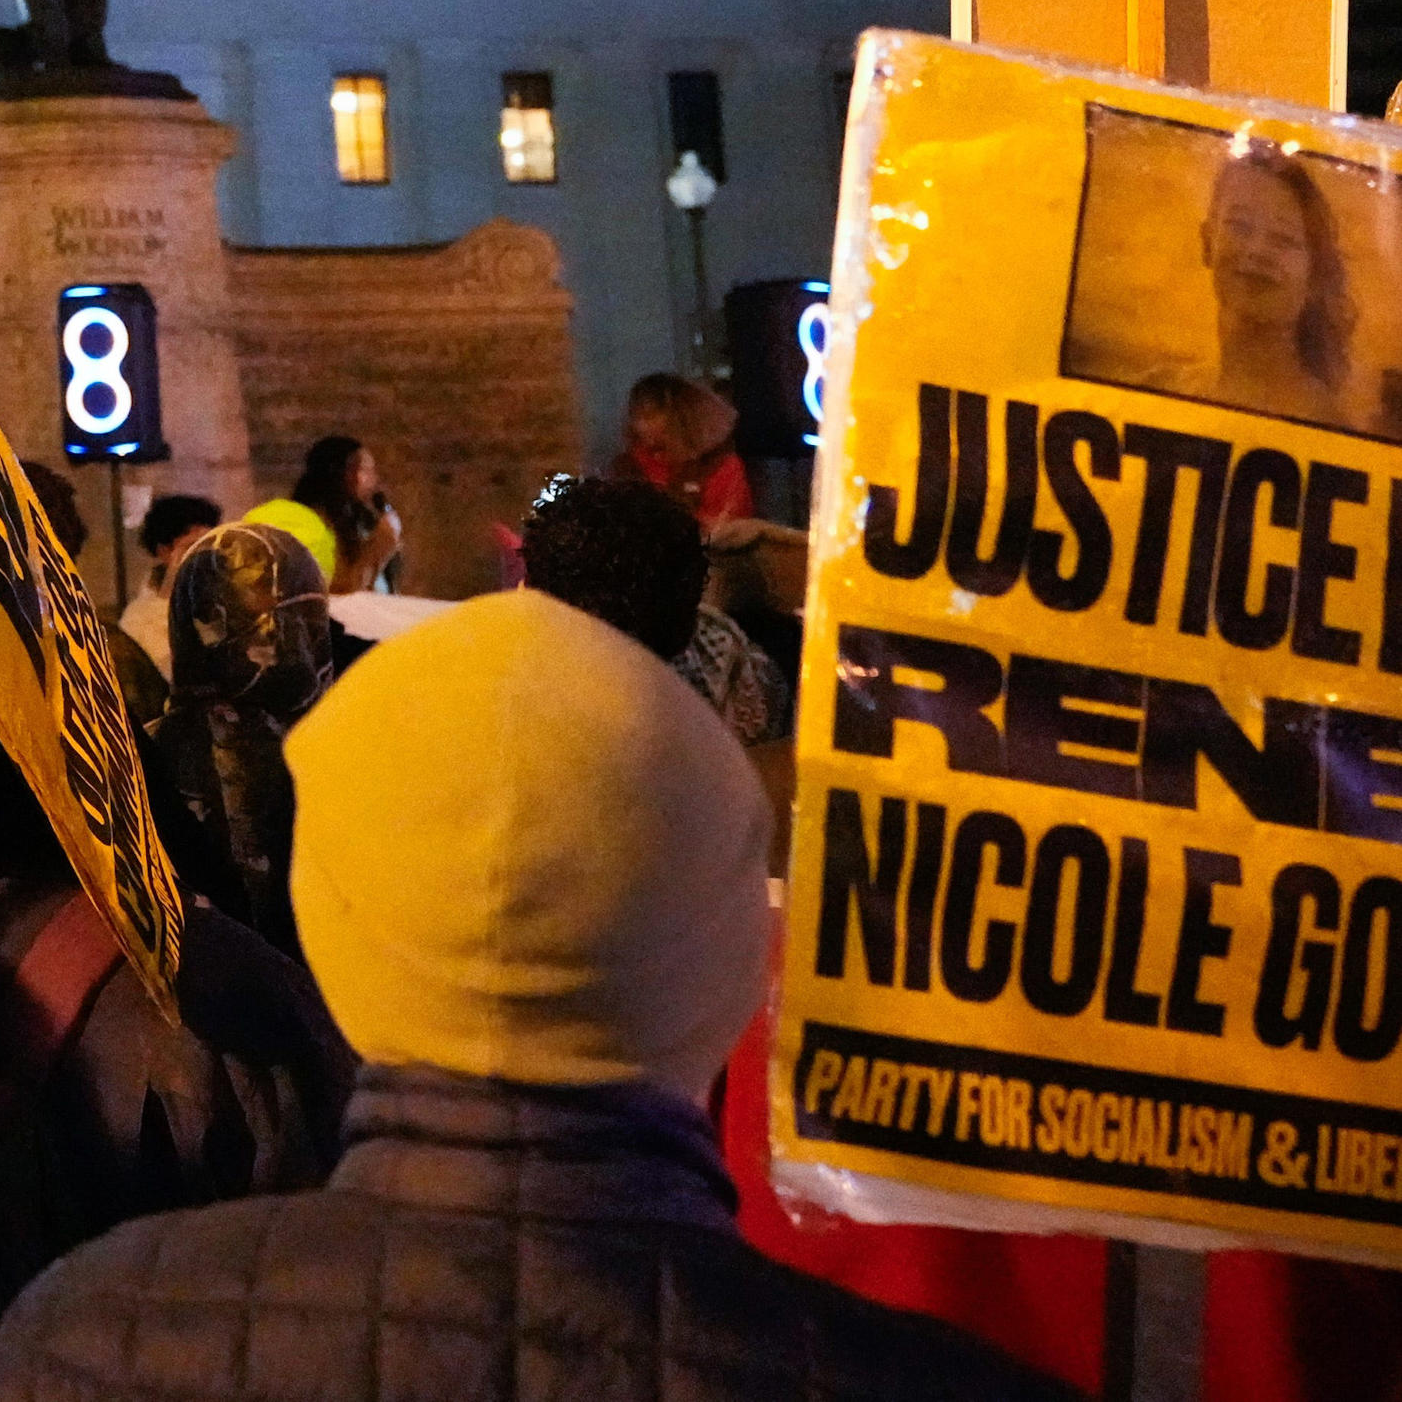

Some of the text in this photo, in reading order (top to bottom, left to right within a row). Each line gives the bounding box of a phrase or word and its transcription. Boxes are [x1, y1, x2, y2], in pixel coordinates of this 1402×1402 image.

[863, 382, 1369, 667] JUSTICE
[833, 624, 1402, 844] RENE
[815, 788, 1402, 1062] NICOLE GO
[804, 1049, 954, 1138] PARTY
[954, 1071, 1033, 1150] FOR
[1037, 1082, 1253, 1180] SOCIALISM
[1257, 1121, 1311, 1189] &
